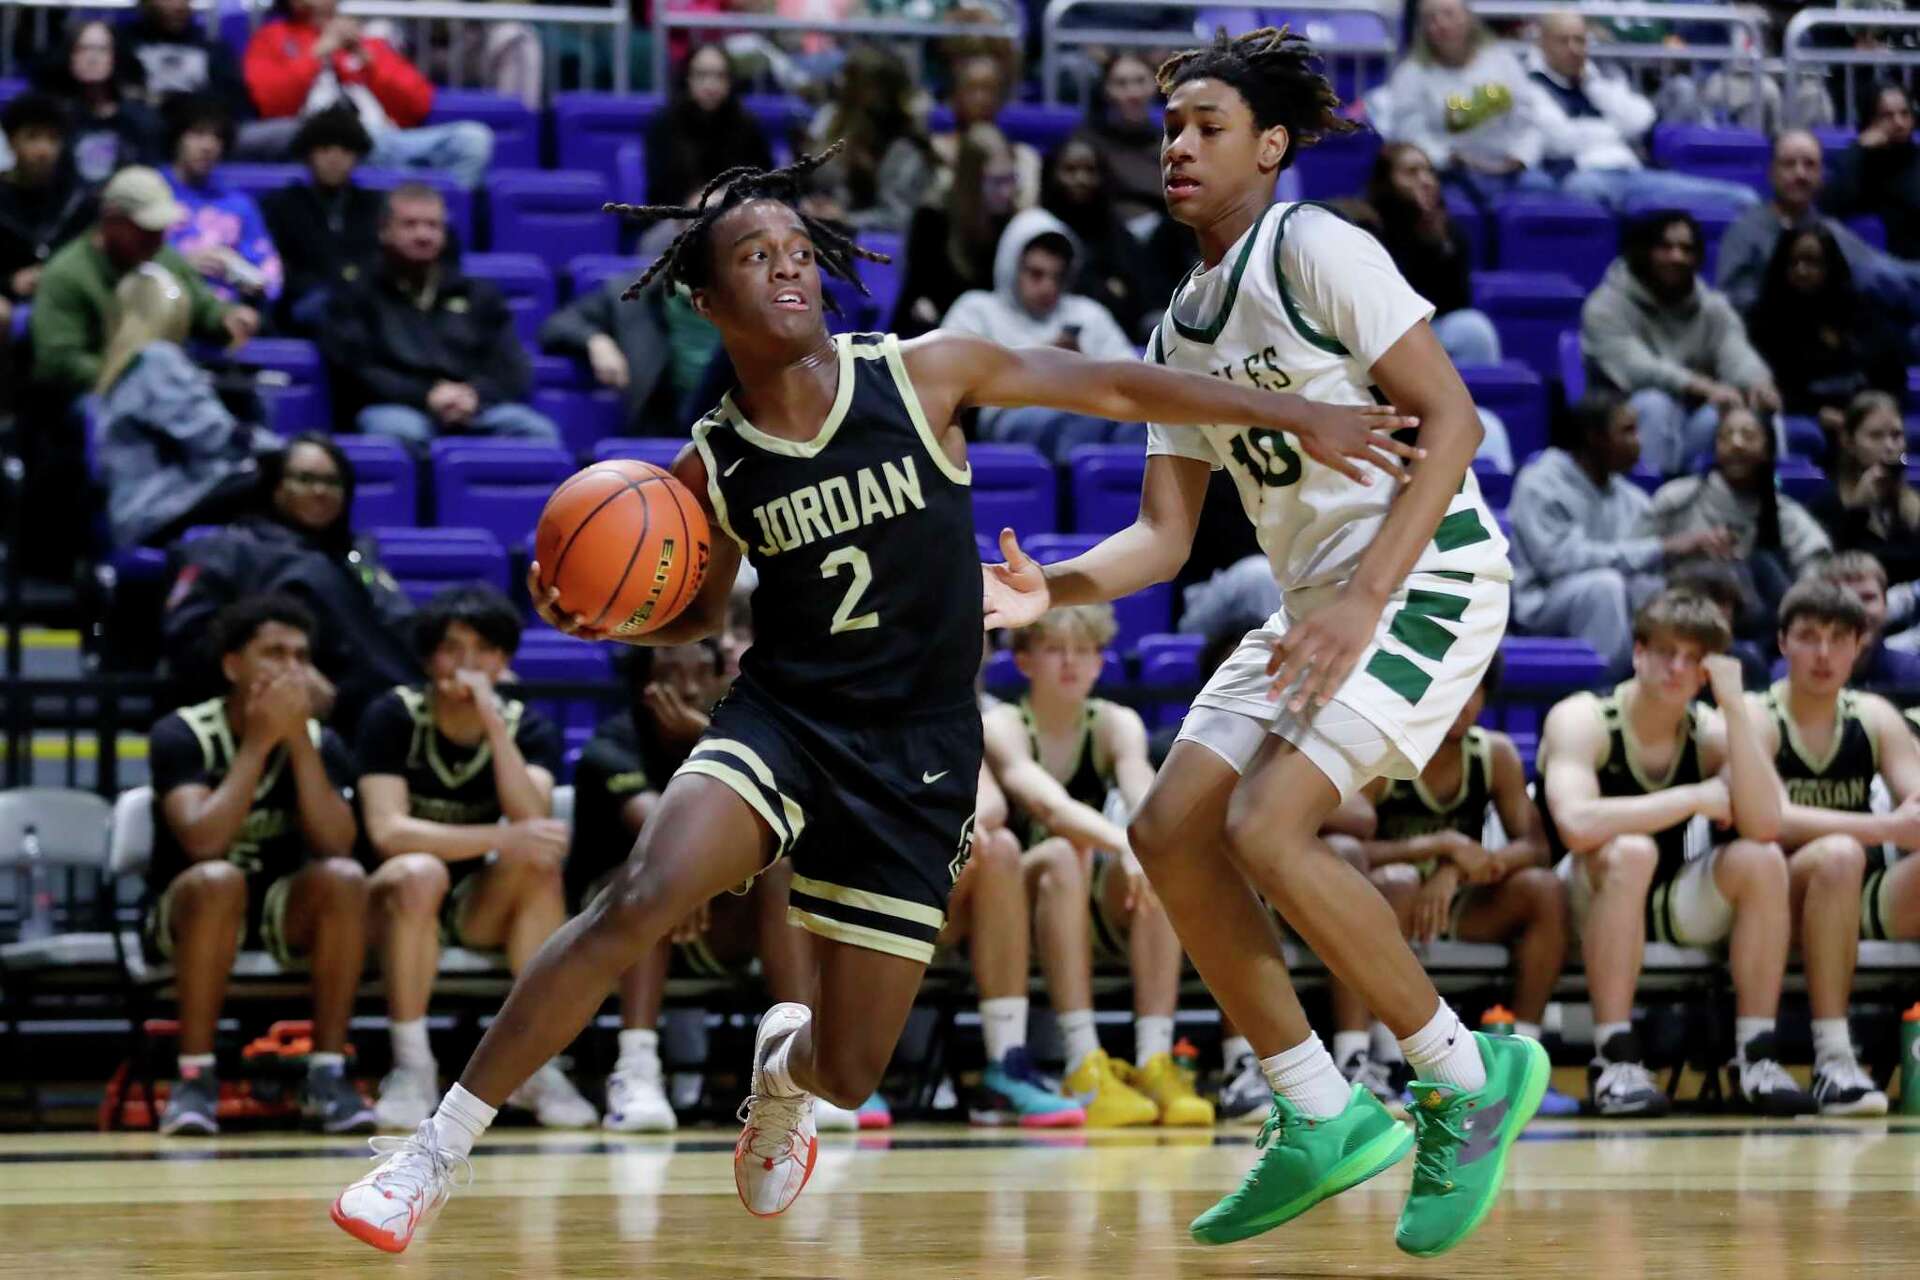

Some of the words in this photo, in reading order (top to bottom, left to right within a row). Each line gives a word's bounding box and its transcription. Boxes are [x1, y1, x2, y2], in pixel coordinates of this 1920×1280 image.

[752, 455, 926, 557] JORDAN
[640, 538, 675, 617] ELITE
[819, 545, 880, 635] 2
